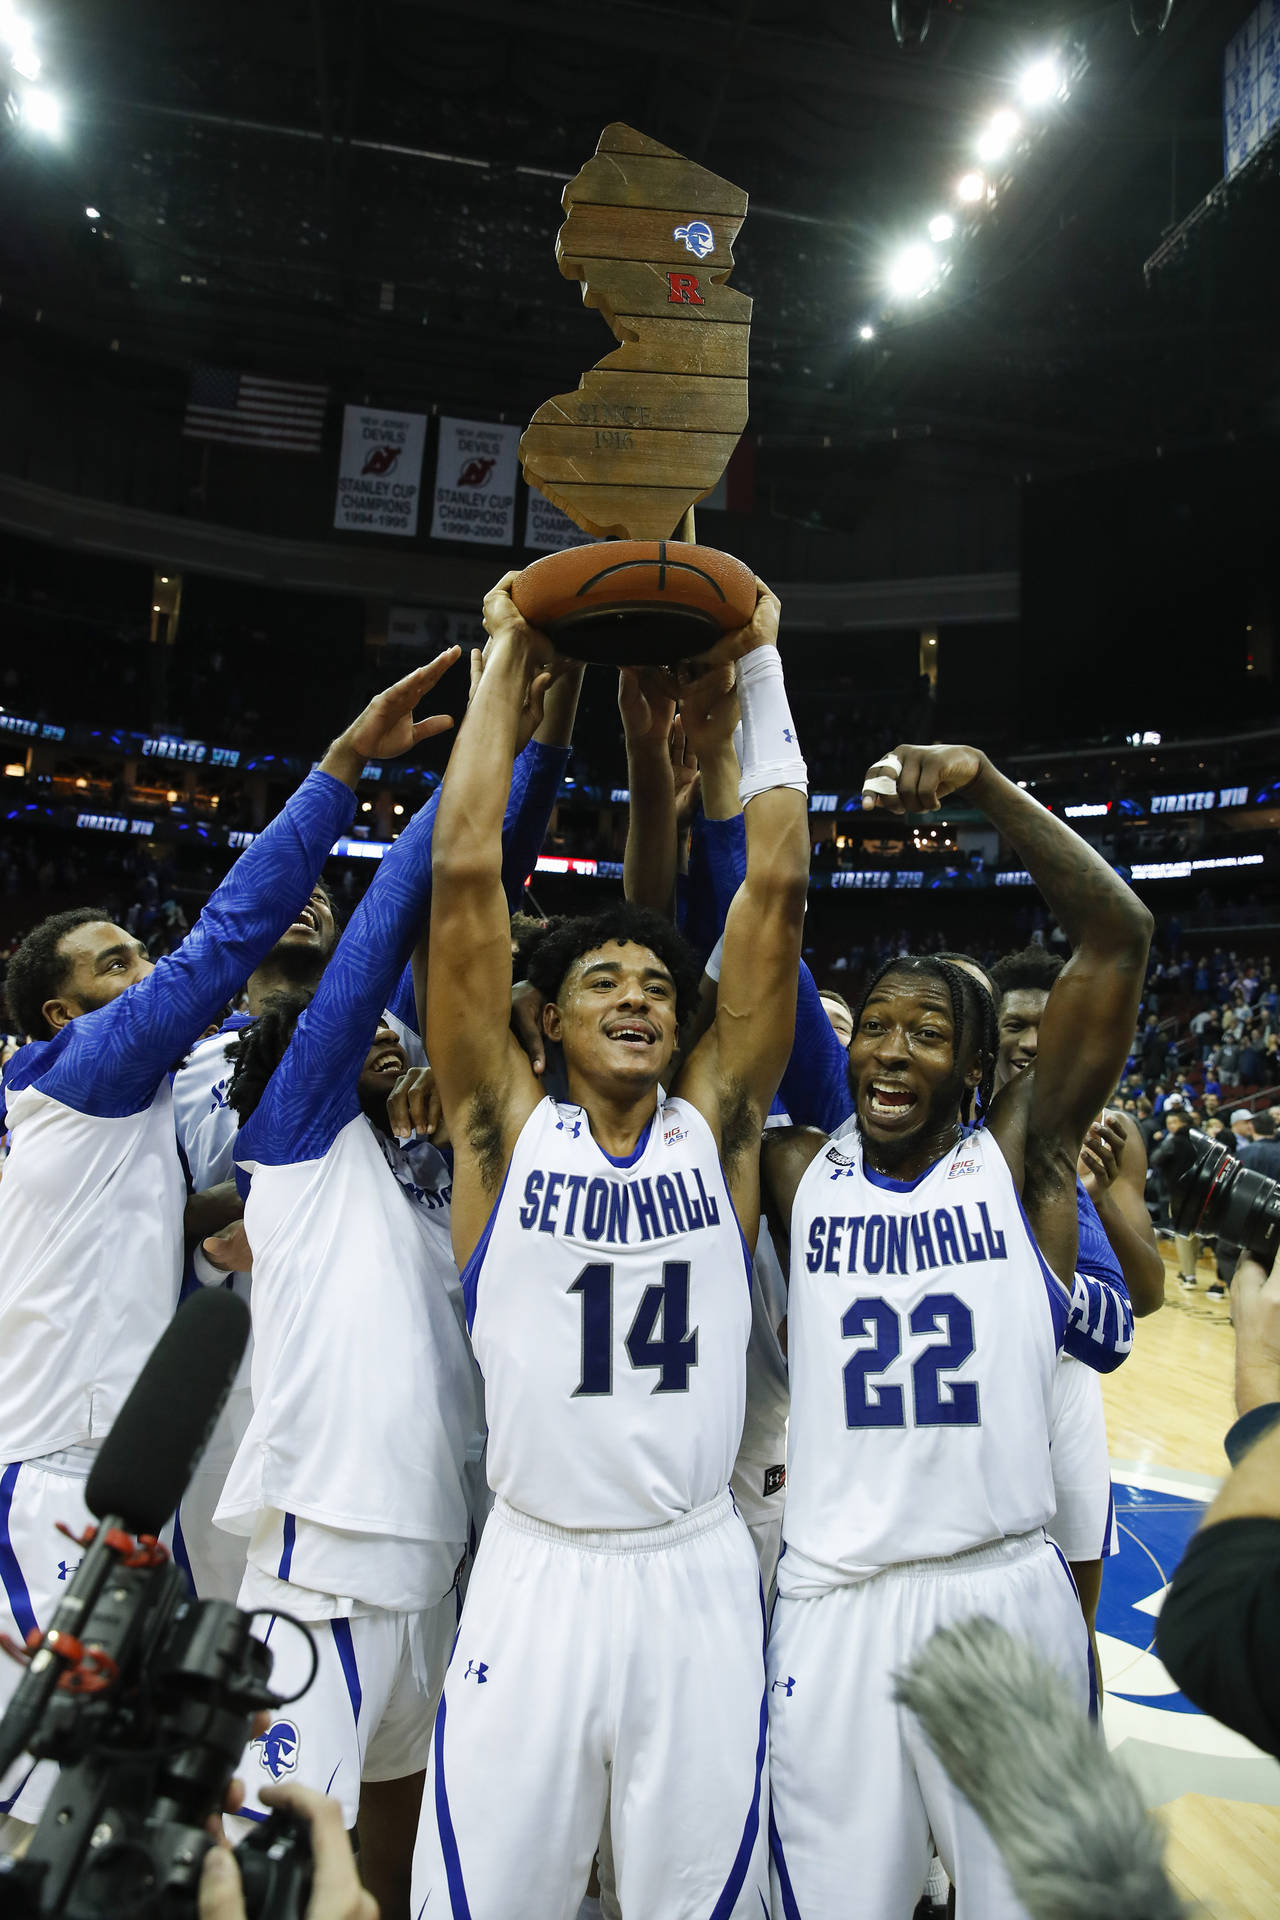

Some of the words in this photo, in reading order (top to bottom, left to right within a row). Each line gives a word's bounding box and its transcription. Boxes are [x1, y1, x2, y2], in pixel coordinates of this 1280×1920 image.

[666, 271, 706, 305] R
[577, 403, 653, 425] SINCE
[362, 427, 407, 443] DEVILS
[458, 440, 501, 455] DEVILS
[338, 477, 391, 496] STANLEY
[392, 483, 417, 499] CUP
[437, 488, 488, 507] STANLEY
[489, 495, 513, 509] CUP
[342, 494, 412, 516] CHAMPIONS
[439, 504, 508, 525] CHAMPIONS
[343, 511, 408, 529] 1994-1995
[441, 521, 505, 538] 1999-2000
[1150, 791, 1216, 814] PIRATES
[1217, 786, 1249, 808] WIN
[76, 814, 128, 833] PIRATES
[664, 1130, 689, 1145] AST
[949, 1165, 984, 1177] EAST
[951, 1159, 975, 1171] BIG
[566, 1260, 699, 1398] 14
[840, 1292, 982, 1430] 22
